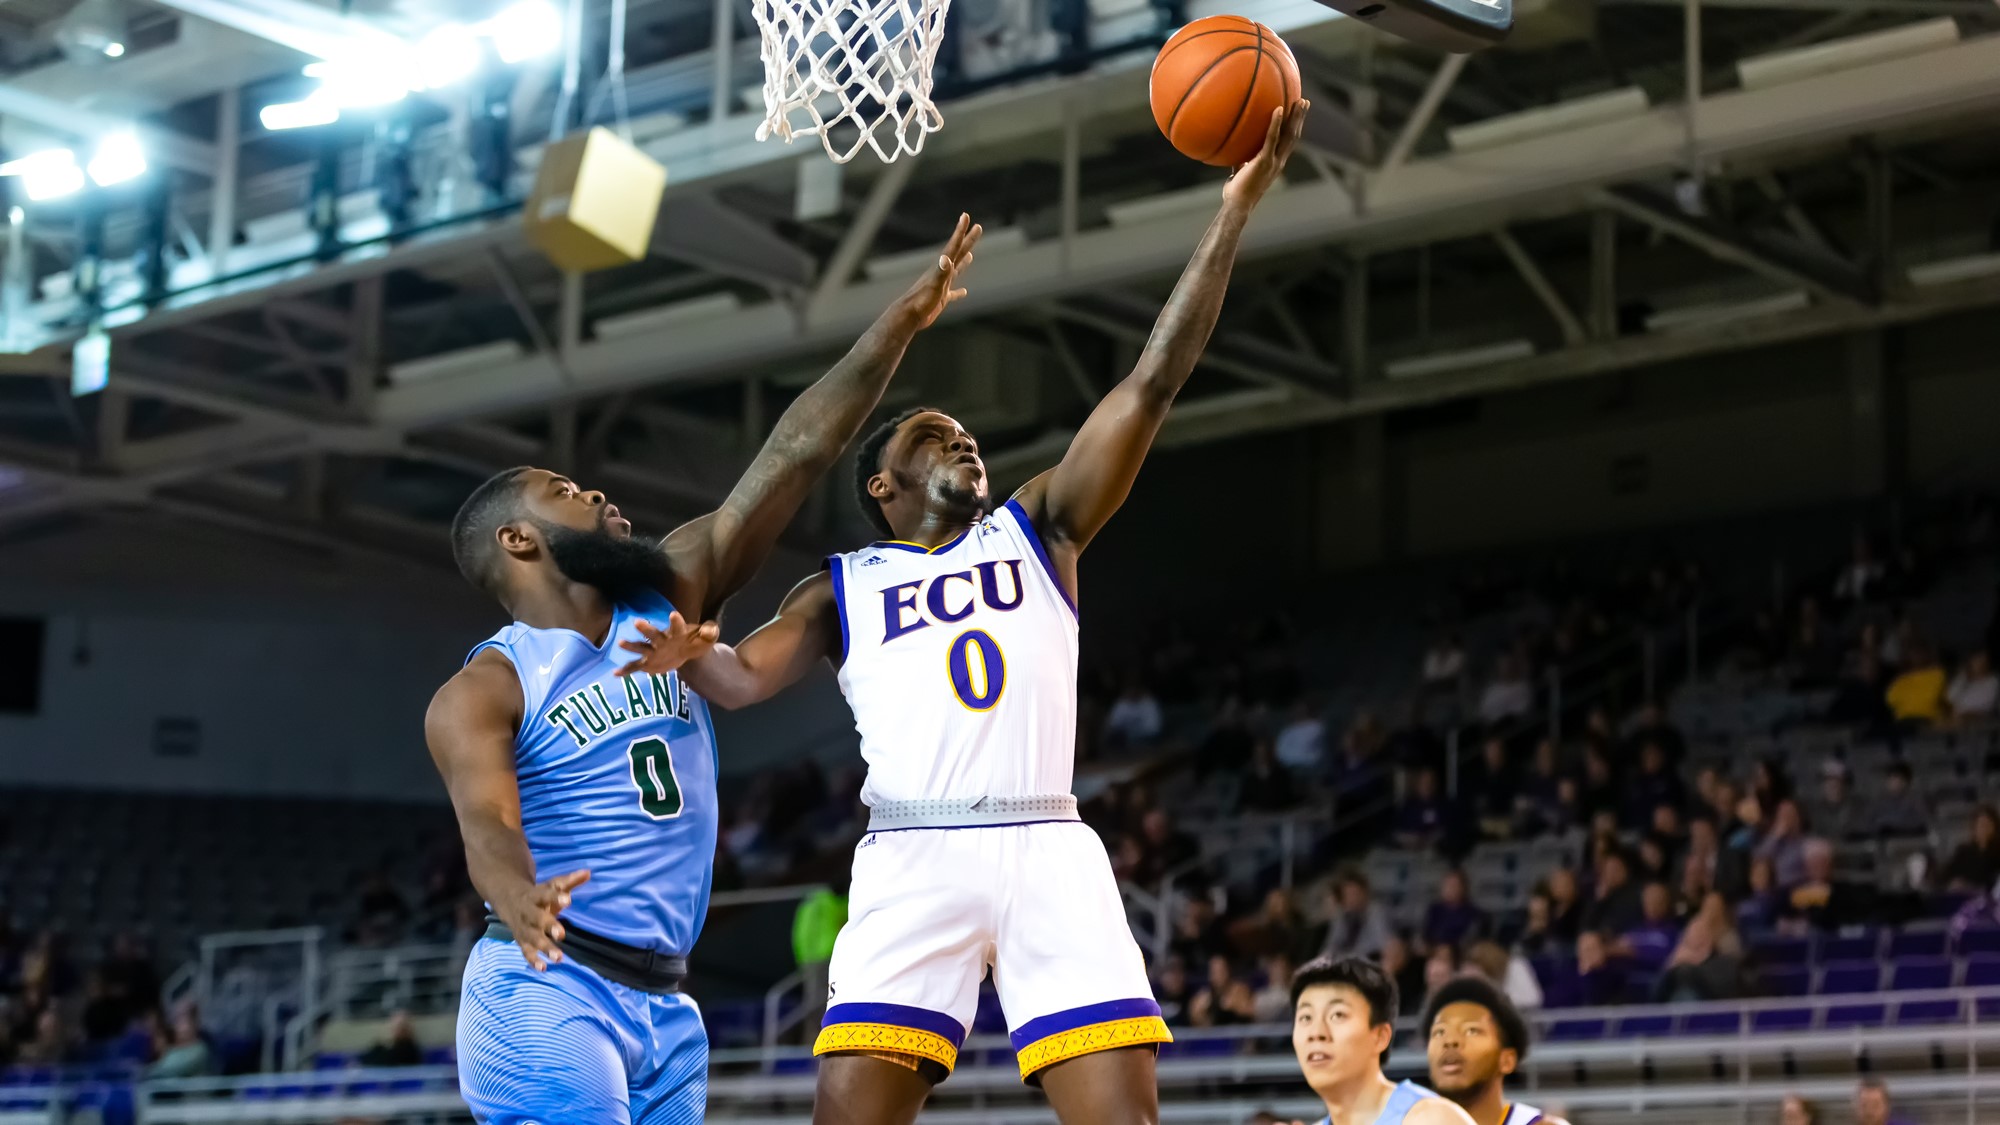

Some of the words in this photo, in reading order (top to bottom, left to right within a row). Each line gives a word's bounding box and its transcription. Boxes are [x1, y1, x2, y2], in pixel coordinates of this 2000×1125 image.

[879, 559, 1024, 646] ECU
[544, 669, 690, 748] TULANE
[946, 628, 1007, 712] 0
[626, 734, 683, 821] 0
